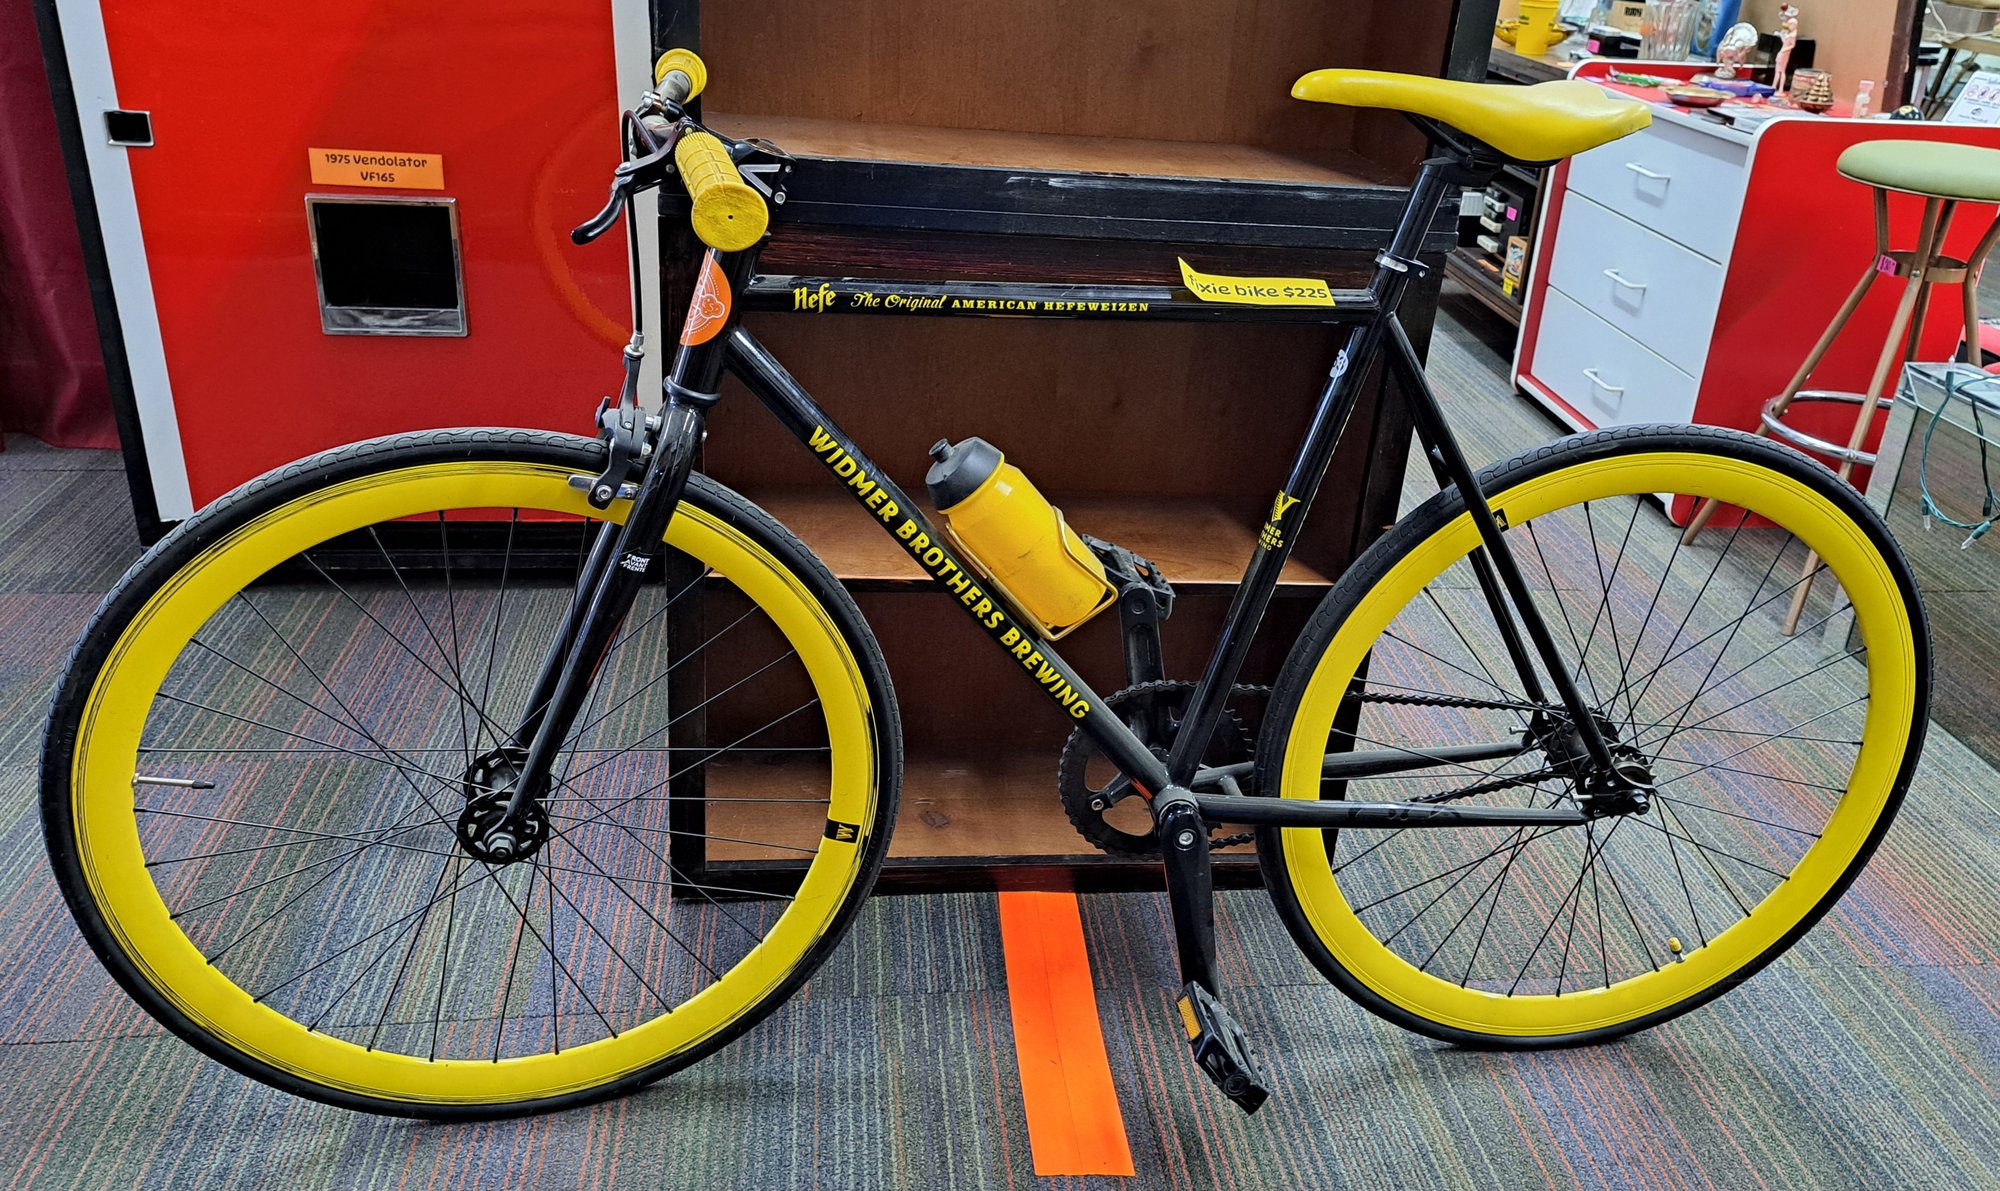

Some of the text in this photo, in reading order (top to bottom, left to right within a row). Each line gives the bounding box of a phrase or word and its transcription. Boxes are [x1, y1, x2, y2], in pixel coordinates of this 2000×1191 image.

[325, 153, 428, 168] 1975 Vendolator
[360, 171, 395, 183] VF165
[1188, 274, 1328, 299] fixie bike $225
[850, 292, 881, 308] The
[885, 294, 948, 312] Original
[951, 299, 1037, 310] AMERICAN
[1043, 301, 1149, 312] HEFEWEIZEN
[808, 425, 1090, 719] WIDMER BROTHERS BREWING
